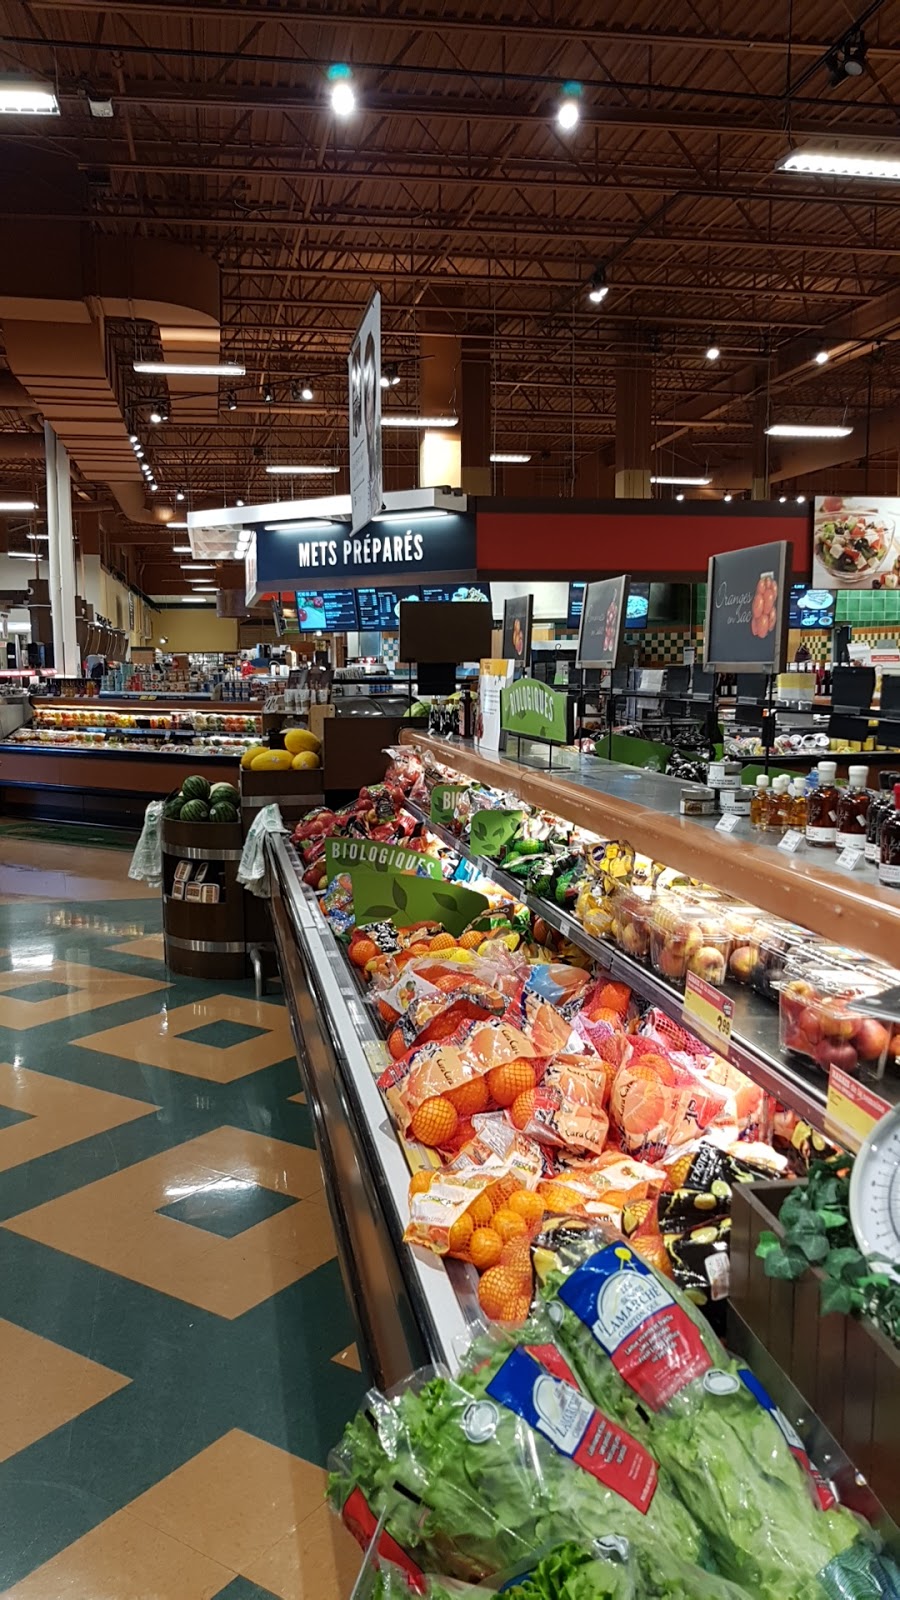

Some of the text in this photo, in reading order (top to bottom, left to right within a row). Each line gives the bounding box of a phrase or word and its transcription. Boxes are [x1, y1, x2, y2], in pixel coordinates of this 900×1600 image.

[298, 529, 424, 567] METS PRÉPARÉS
[715, 581, 752, 613] Oranges
[509, 686, 555, 722] BIOLOGIQUES
